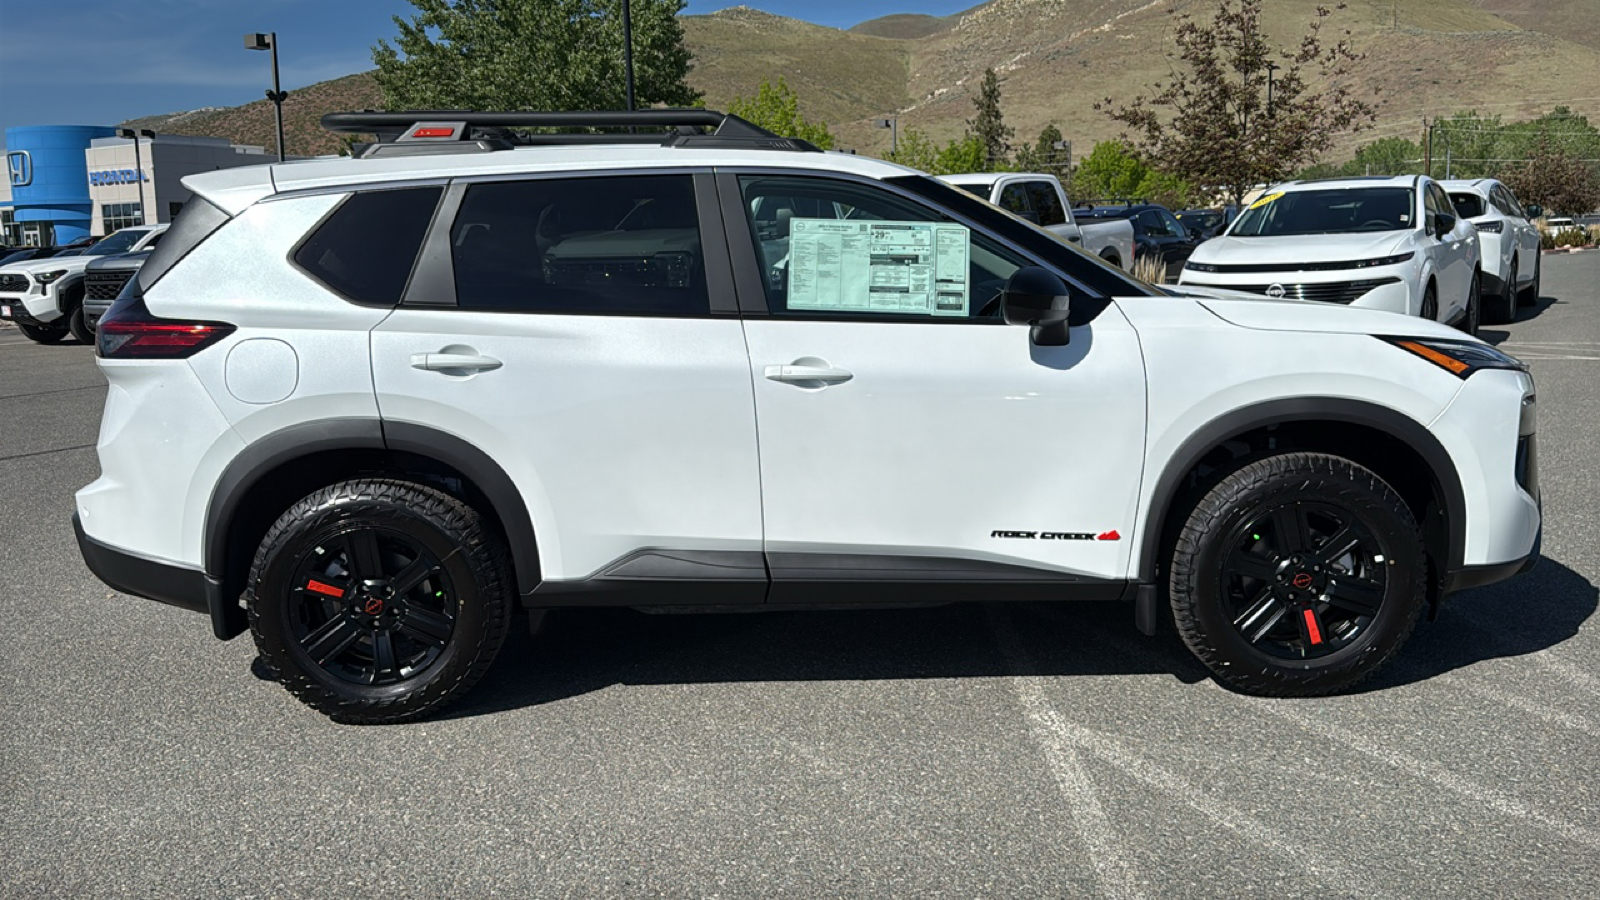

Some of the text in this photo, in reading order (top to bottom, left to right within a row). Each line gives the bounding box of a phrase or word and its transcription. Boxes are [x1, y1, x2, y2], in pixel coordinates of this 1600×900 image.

[89, 169, 147, 184] HONDA
[990, 530, 1097, 541] ROCK CREEK
